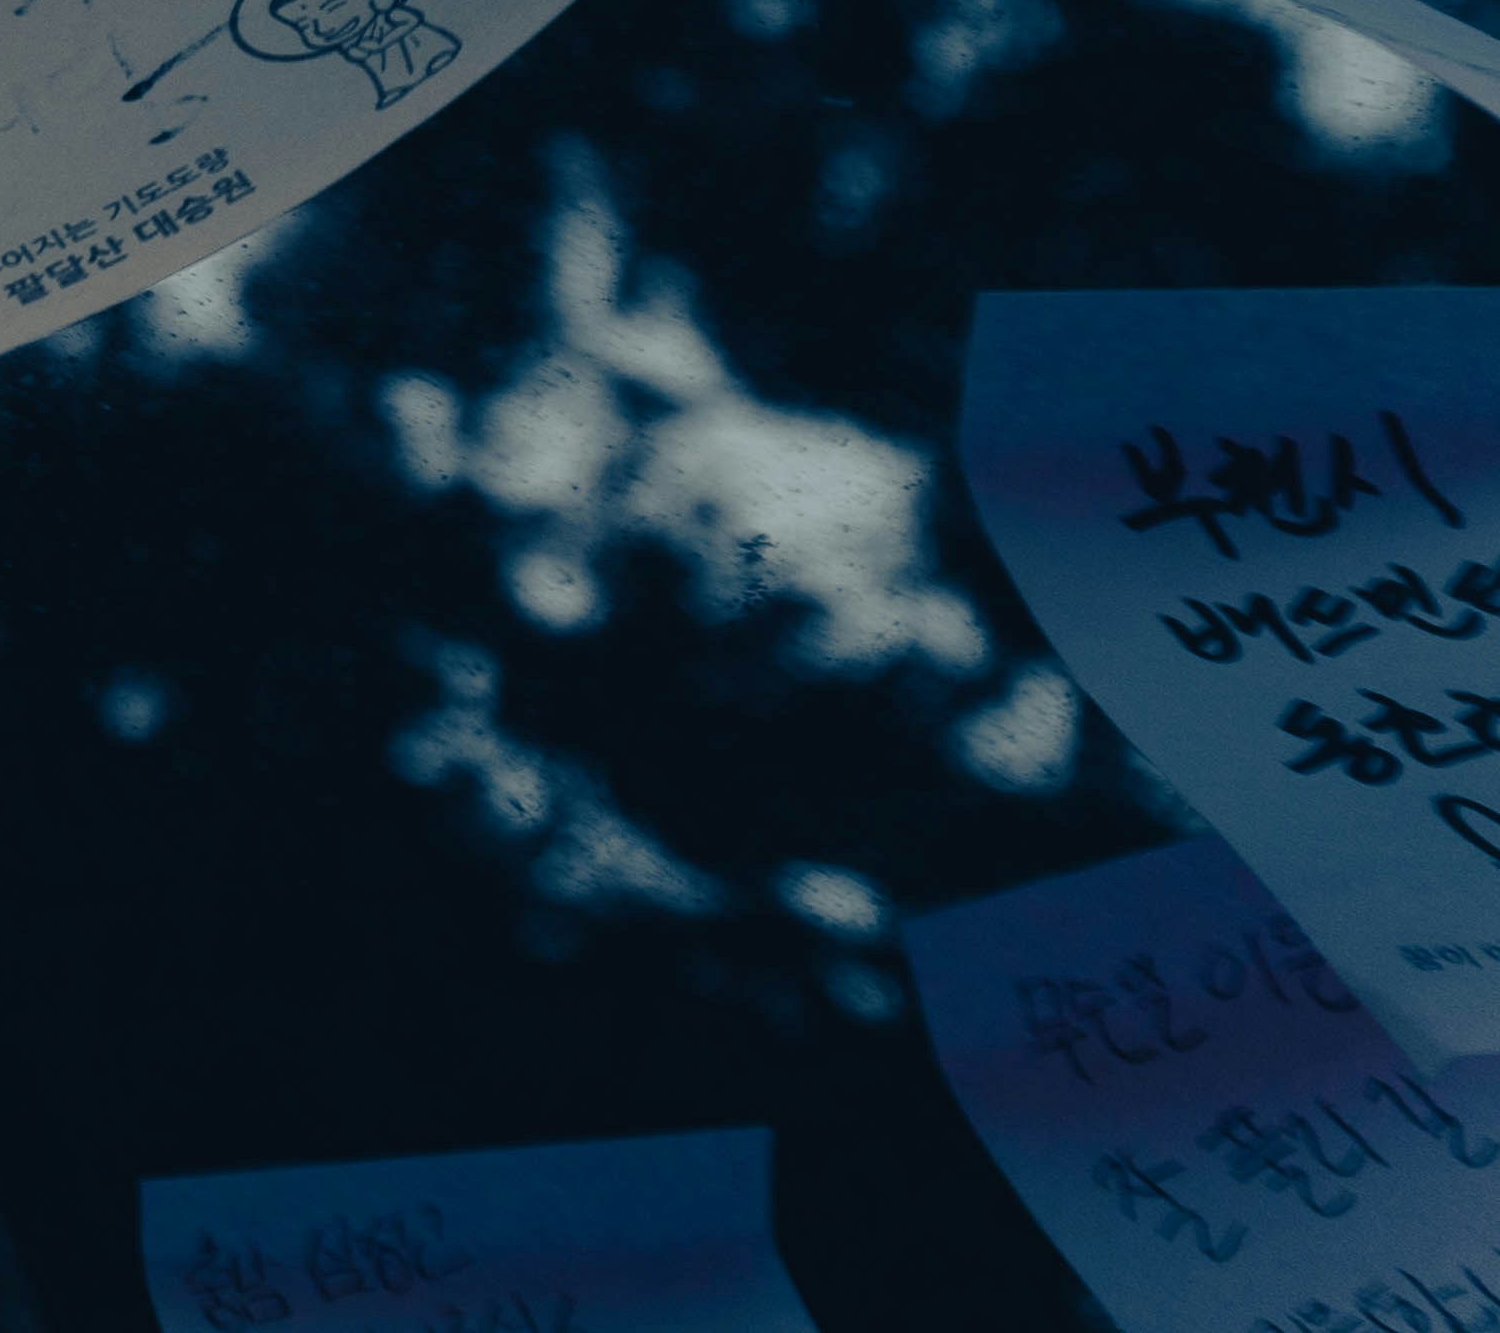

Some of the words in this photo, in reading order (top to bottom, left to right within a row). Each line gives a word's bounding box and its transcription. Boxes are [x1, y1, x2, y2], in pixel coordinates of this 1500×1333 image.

[4, 233, 130, 307] 팔달산
[133, 168, 258, 245] 대승원
[102, 146, 230, 222] 기도도량
